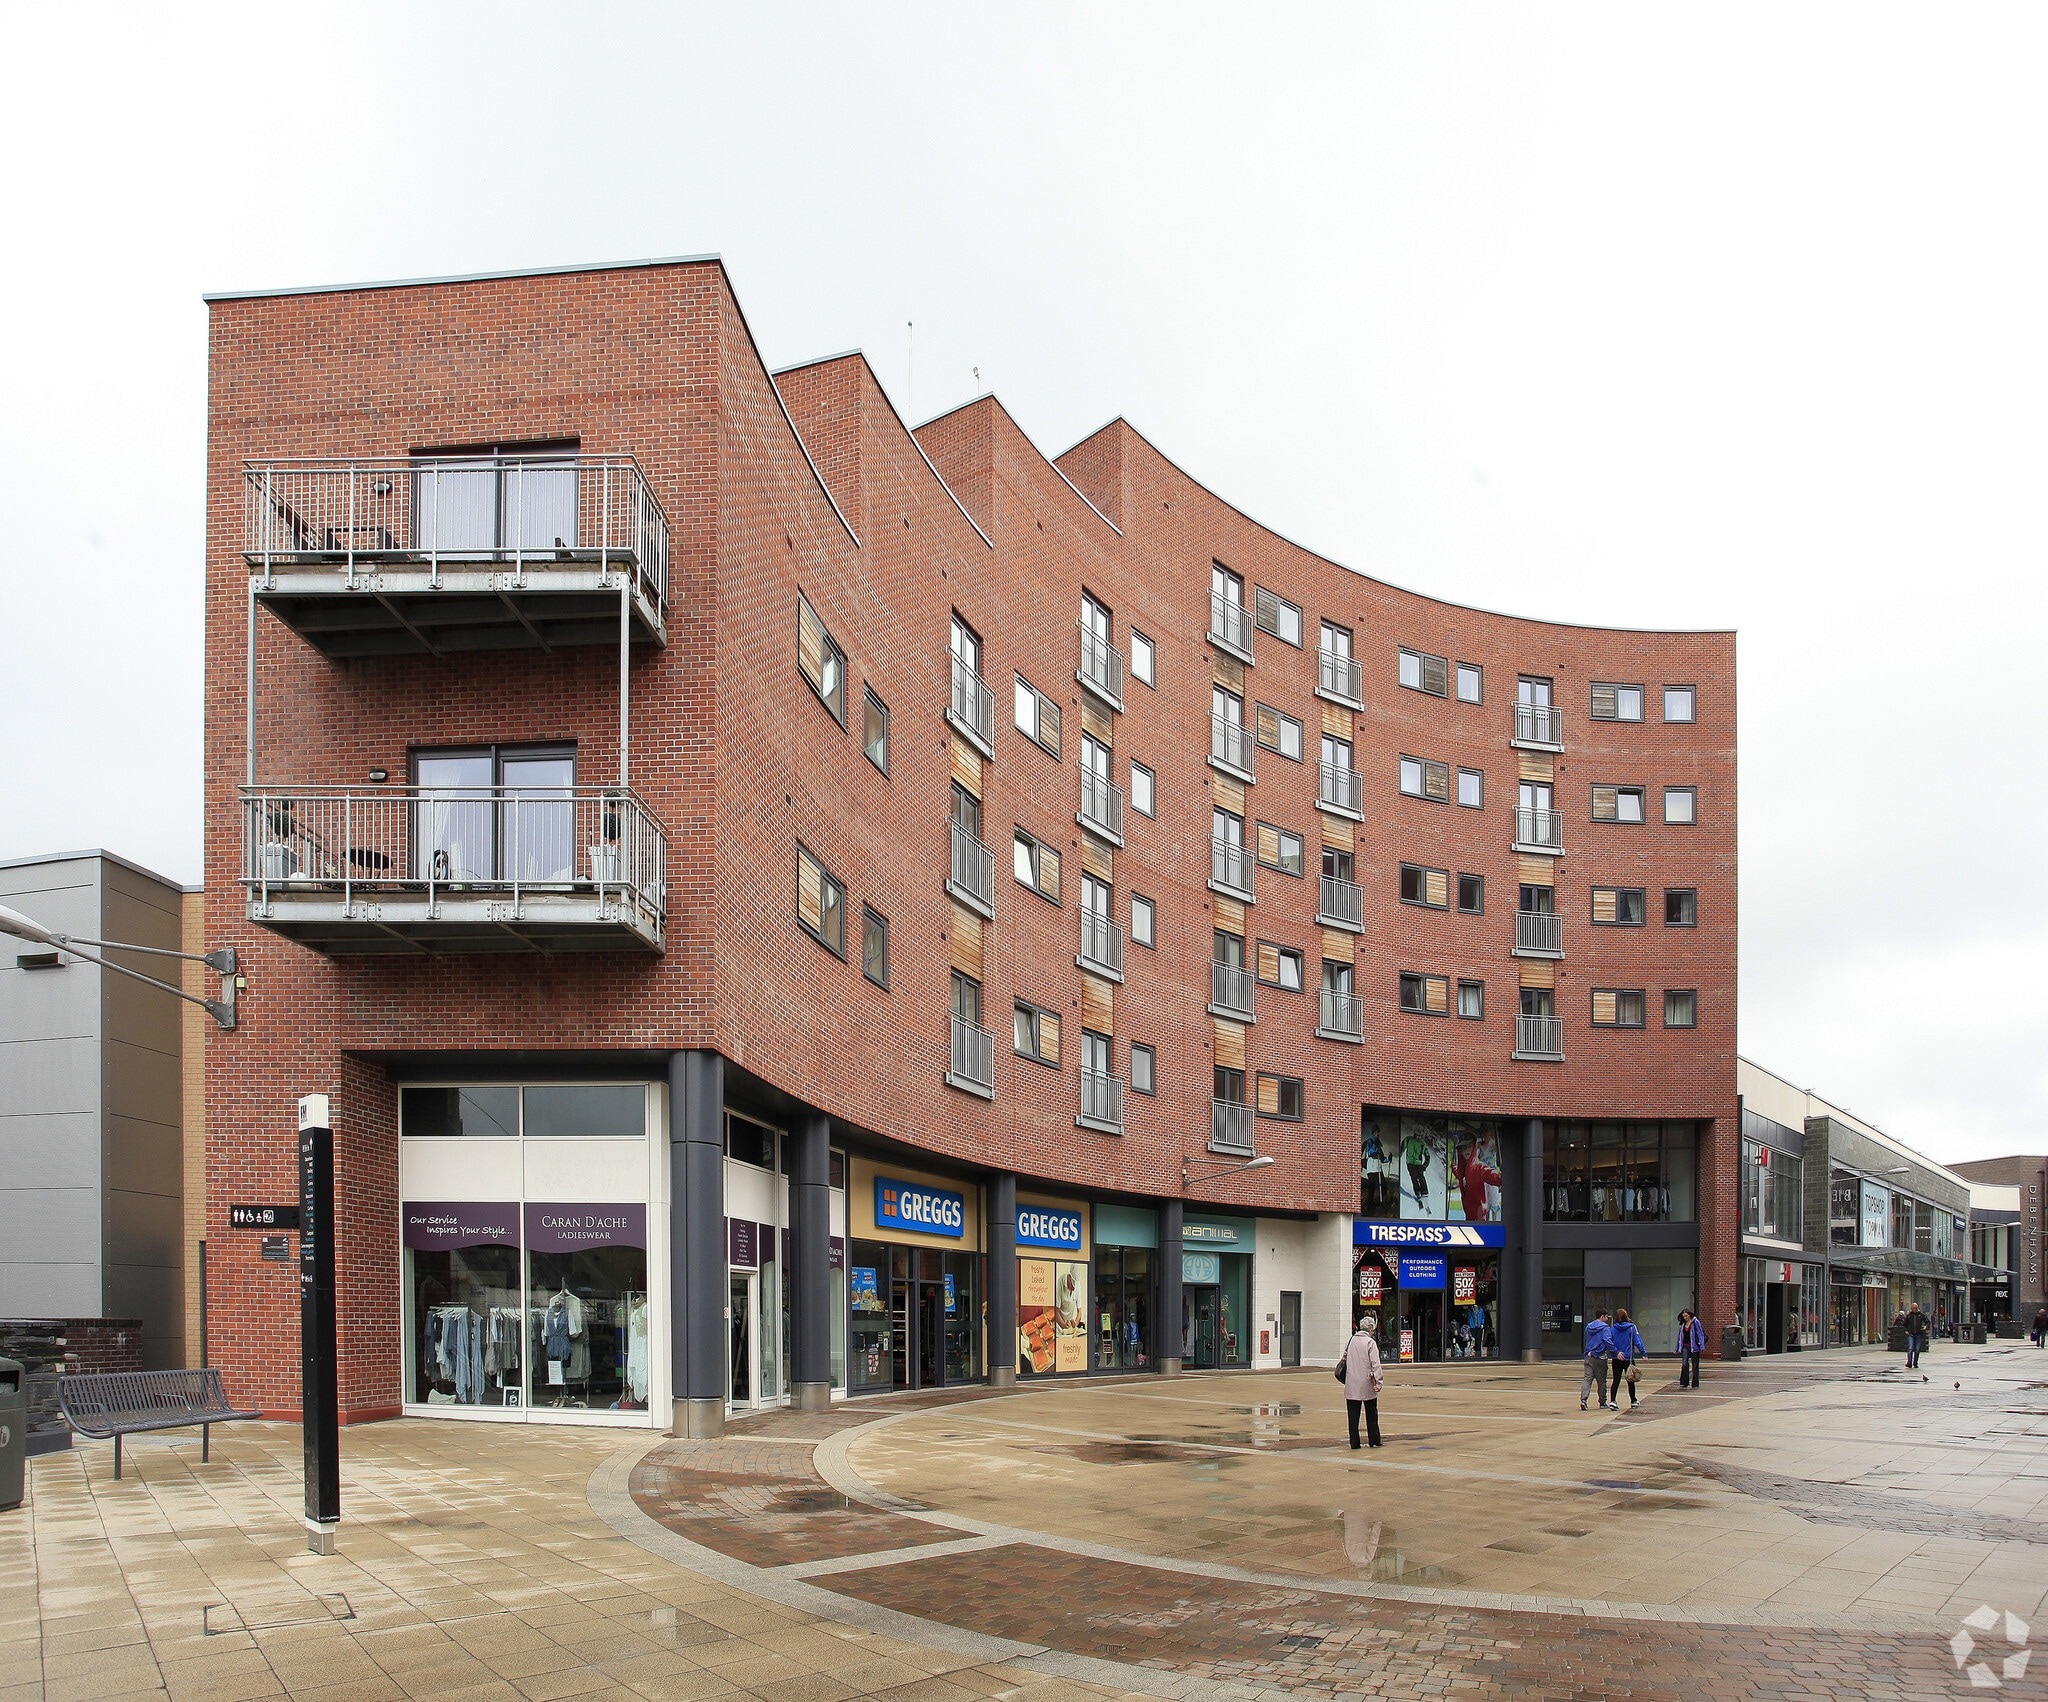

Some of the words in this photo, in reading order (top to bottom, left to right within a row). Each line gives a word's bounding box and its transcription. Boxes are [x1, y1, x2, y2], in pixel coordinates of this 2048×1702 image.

[900, 1191, 962, 1228] GREGGS
[410, 1216, 427, 1224] Our
[428, 1215, 458, 1224] Service
[541, 1215, 581, 1228] CARAN
[585, 1215, 627, 1228] D'ACHE
[426, 1224, 459, 1237] Inspires
[459, 1226, 481, 1237] Your
[481, 1226, 513, 1239] Style...
[1018, 1212, 1079, 1241] GREGGS
[557, 1231, 611, 1239] LADIESWEAR
[1369, 1225, 1444, 1242] TRESPASS
[2029, 1185, 2037, 1283] DEBENHAMS
[1361, 1277, 1380, 1288] 50%
[1455, 1277, 1474, 1288] 50%
[1361, 1288, 1380, 1298] OFF
[1455, 1288, 1474, 1298] OFF
[1062, 1343, 1081, 1358] freshly
